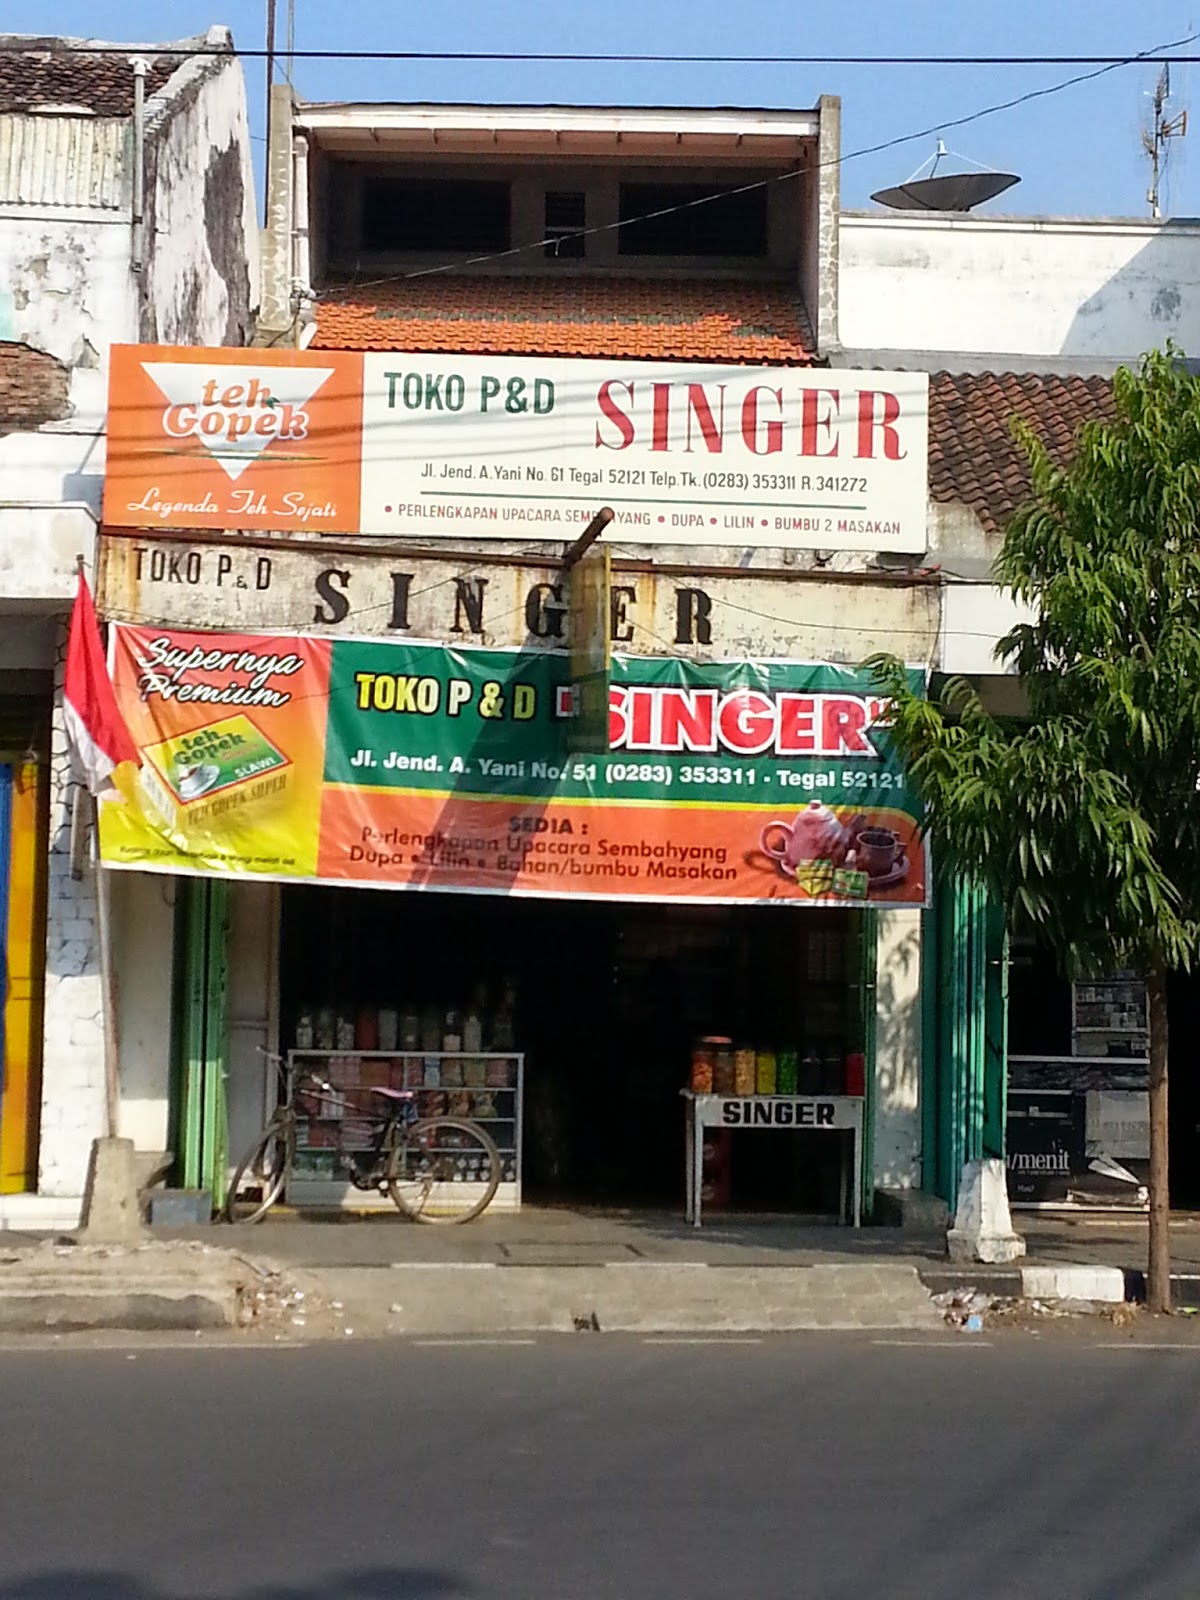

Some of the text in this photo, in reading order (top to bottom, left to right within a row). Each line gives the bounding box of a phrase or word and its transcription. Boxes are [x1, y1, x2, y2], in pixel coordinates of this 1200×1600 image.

[202, 378, 272, 409] teh
[383, 371, 555, 415] TOKO P&D
[164, 402, 308, 443] Gopek
[595, 379, 908, 461] SINGER
[421, 463, 437, 479] Jl.
[440, 463, 477, 480] Jend.
[551, 467, 564, 483] 61
[569, 467, 603, 486] Tegal
[608, 469, 646, 485] 52121
[752, 474, 796, 490] 353311
[128, 487, 337, 522] Legenda Teh Sejati
[398, 503, 901, 535] PERLENGKAPAN UPACARA SEMYANG DUPA LILIN BUMBU 2 MASAKAN
[133, 547, 202, 585] TOKO
[313, 568, 714, 646] SINGER
[135, 636, 305, 689] Supernya
[138, 673, 292, 708] Premium
[355, 672, 440, 715] TOKO
[448, 678, 473, 716] P
[478, 682, 504, 719] &
[513, 684, 537, 720] D
[173, 732, 247, 765] Gopek
[181, 729, 221, 751] teh
[351, 750, 377, 767] Jl.
[383, 752, 443, 772] Jend.
[449, 756, 471, 774] A.
[478, 758, 524, 777] Yani
[531, 762, 567, 780] No.
[572, 764, 596, 781] 51
[605, 763, 673, 785] (0283)
[679, 764, 756, 786] 353311
[776, 769, 835, 789] Tegal
[841, 769, 903, 789] 52121
[508, 815, 574, 834] SEDIA
[350, 845, 403, 867] Dupa
[496, 854, 640, 877] Bahan/bumbu
[646, 861, 738, 880] Masakan
[507, 836, 591, 859] Upacara
[597, 839, 727, 863] Sembahyang
[722, 1101, 836, 1126] SINGER
